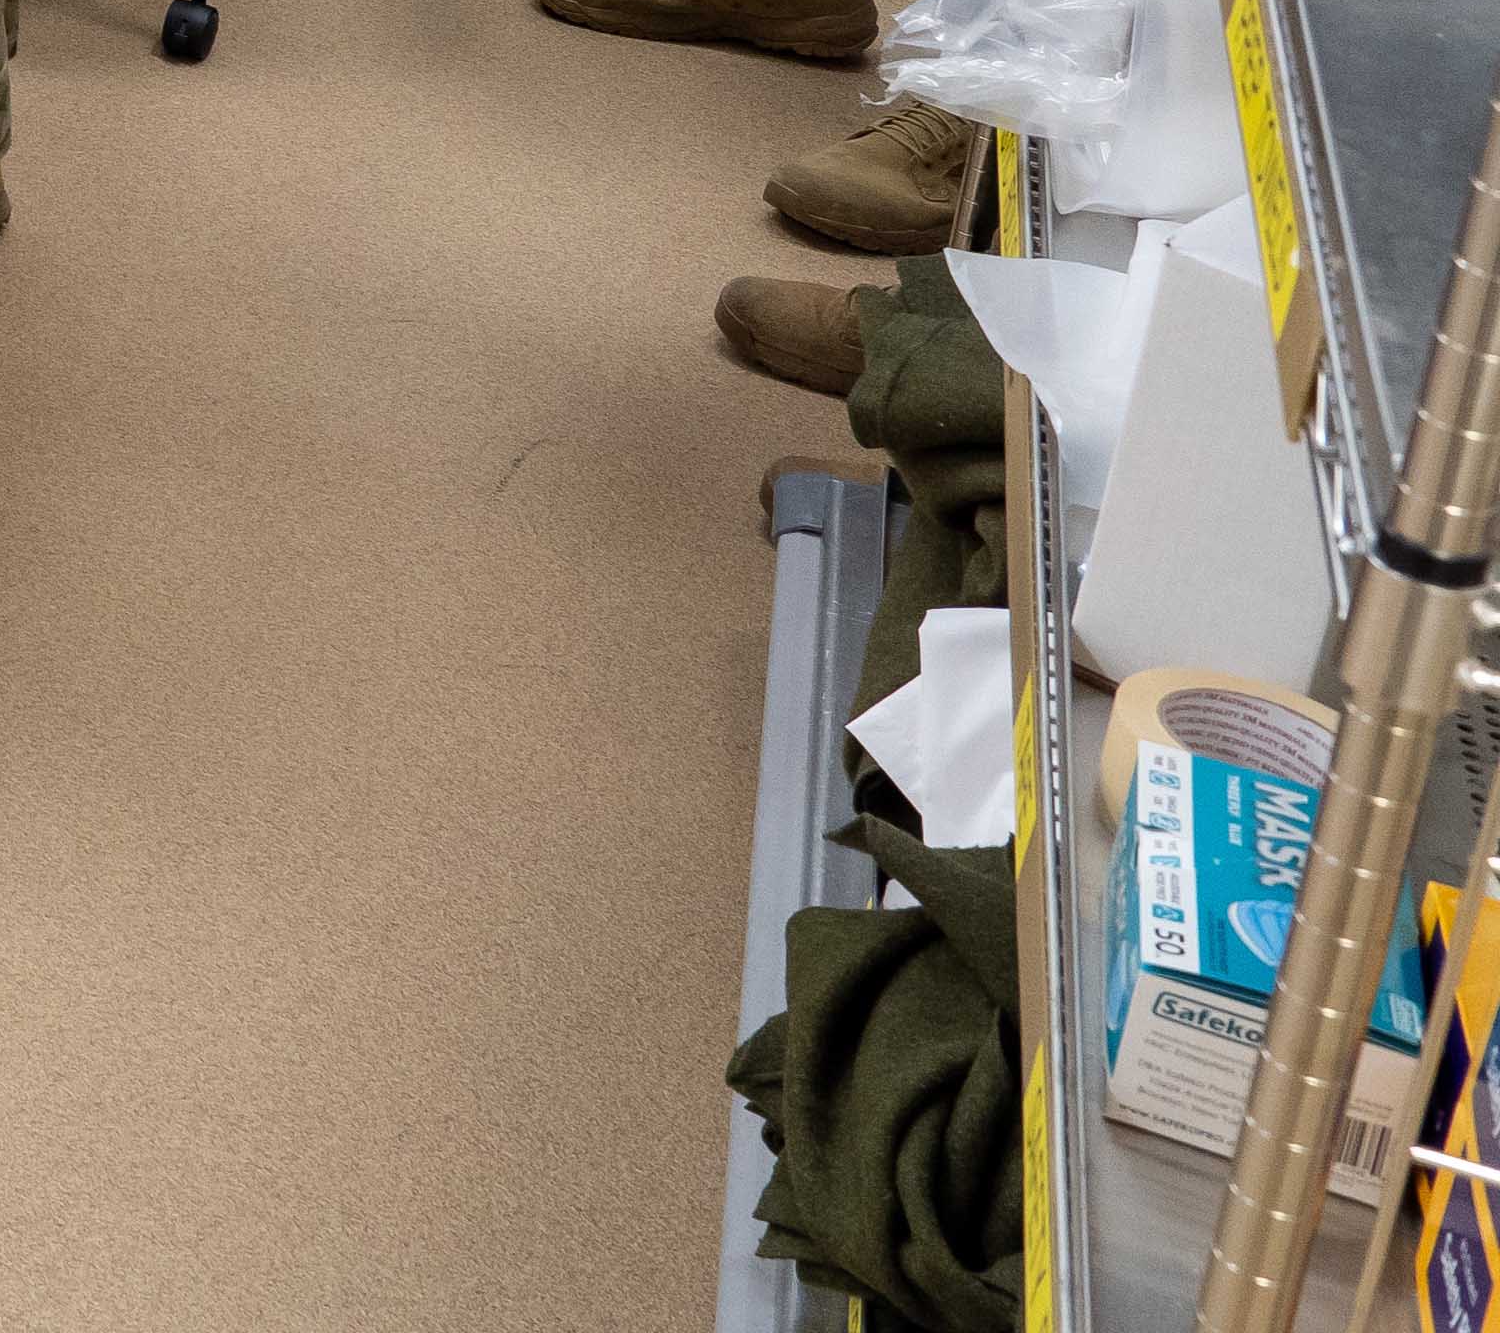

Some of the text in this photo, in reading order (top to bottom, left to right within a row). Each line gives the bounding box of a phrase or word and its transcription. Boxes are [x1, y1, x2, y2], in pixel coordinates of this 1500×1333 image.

[1253, 781, 1312, 890] MASK
[1155, 928, 1185, 956] 50
[1157, 997, 1265, 1044] Safeko
